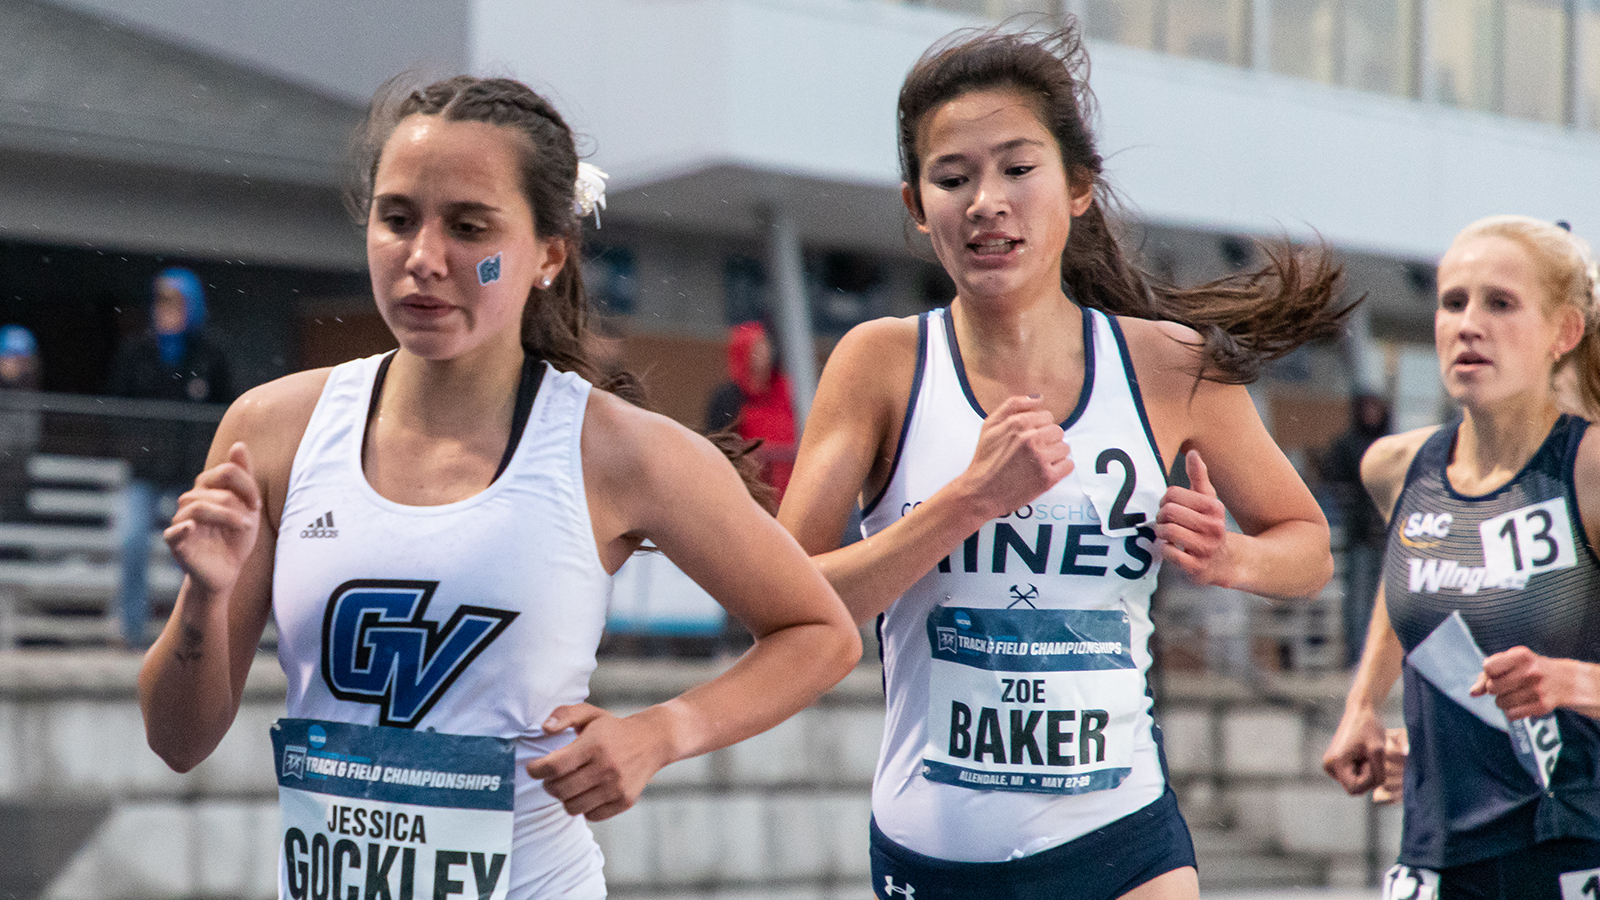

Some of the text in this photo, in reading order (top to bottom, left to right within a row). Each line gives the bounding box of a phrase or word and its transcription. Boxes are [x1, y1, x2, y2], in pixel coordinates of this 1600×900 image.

[1095, 447, 1146, 531] 2
[300, 528, 339, 539] adidas
[1404, 512, 1453, 538] SAC
[1499, 509, 1560, 571] 13
[321, 578, 521, 729] GV
[958, 636, 987, 653] TRACK
[995, 641, 1028, 656] FIELD
[1030, 641, 1122, 656] CHAMPIONSHIPS
[1001, 679, 1046, 704] ZOE
[948, 700, 1109, 767] BAKER
[306, 756, 338, 776] TRACK
[347, 762, 382, 782] FIELD
[383, 767, 501, 791] CHAMPIONSHIPS
[959, 771, 1008, 786] ALLENDALE,
[1010, 775, 1024, 786] MI
[1041, 777, 1063, 788] MAY
[328, 804, 427, 844] JESSICA
